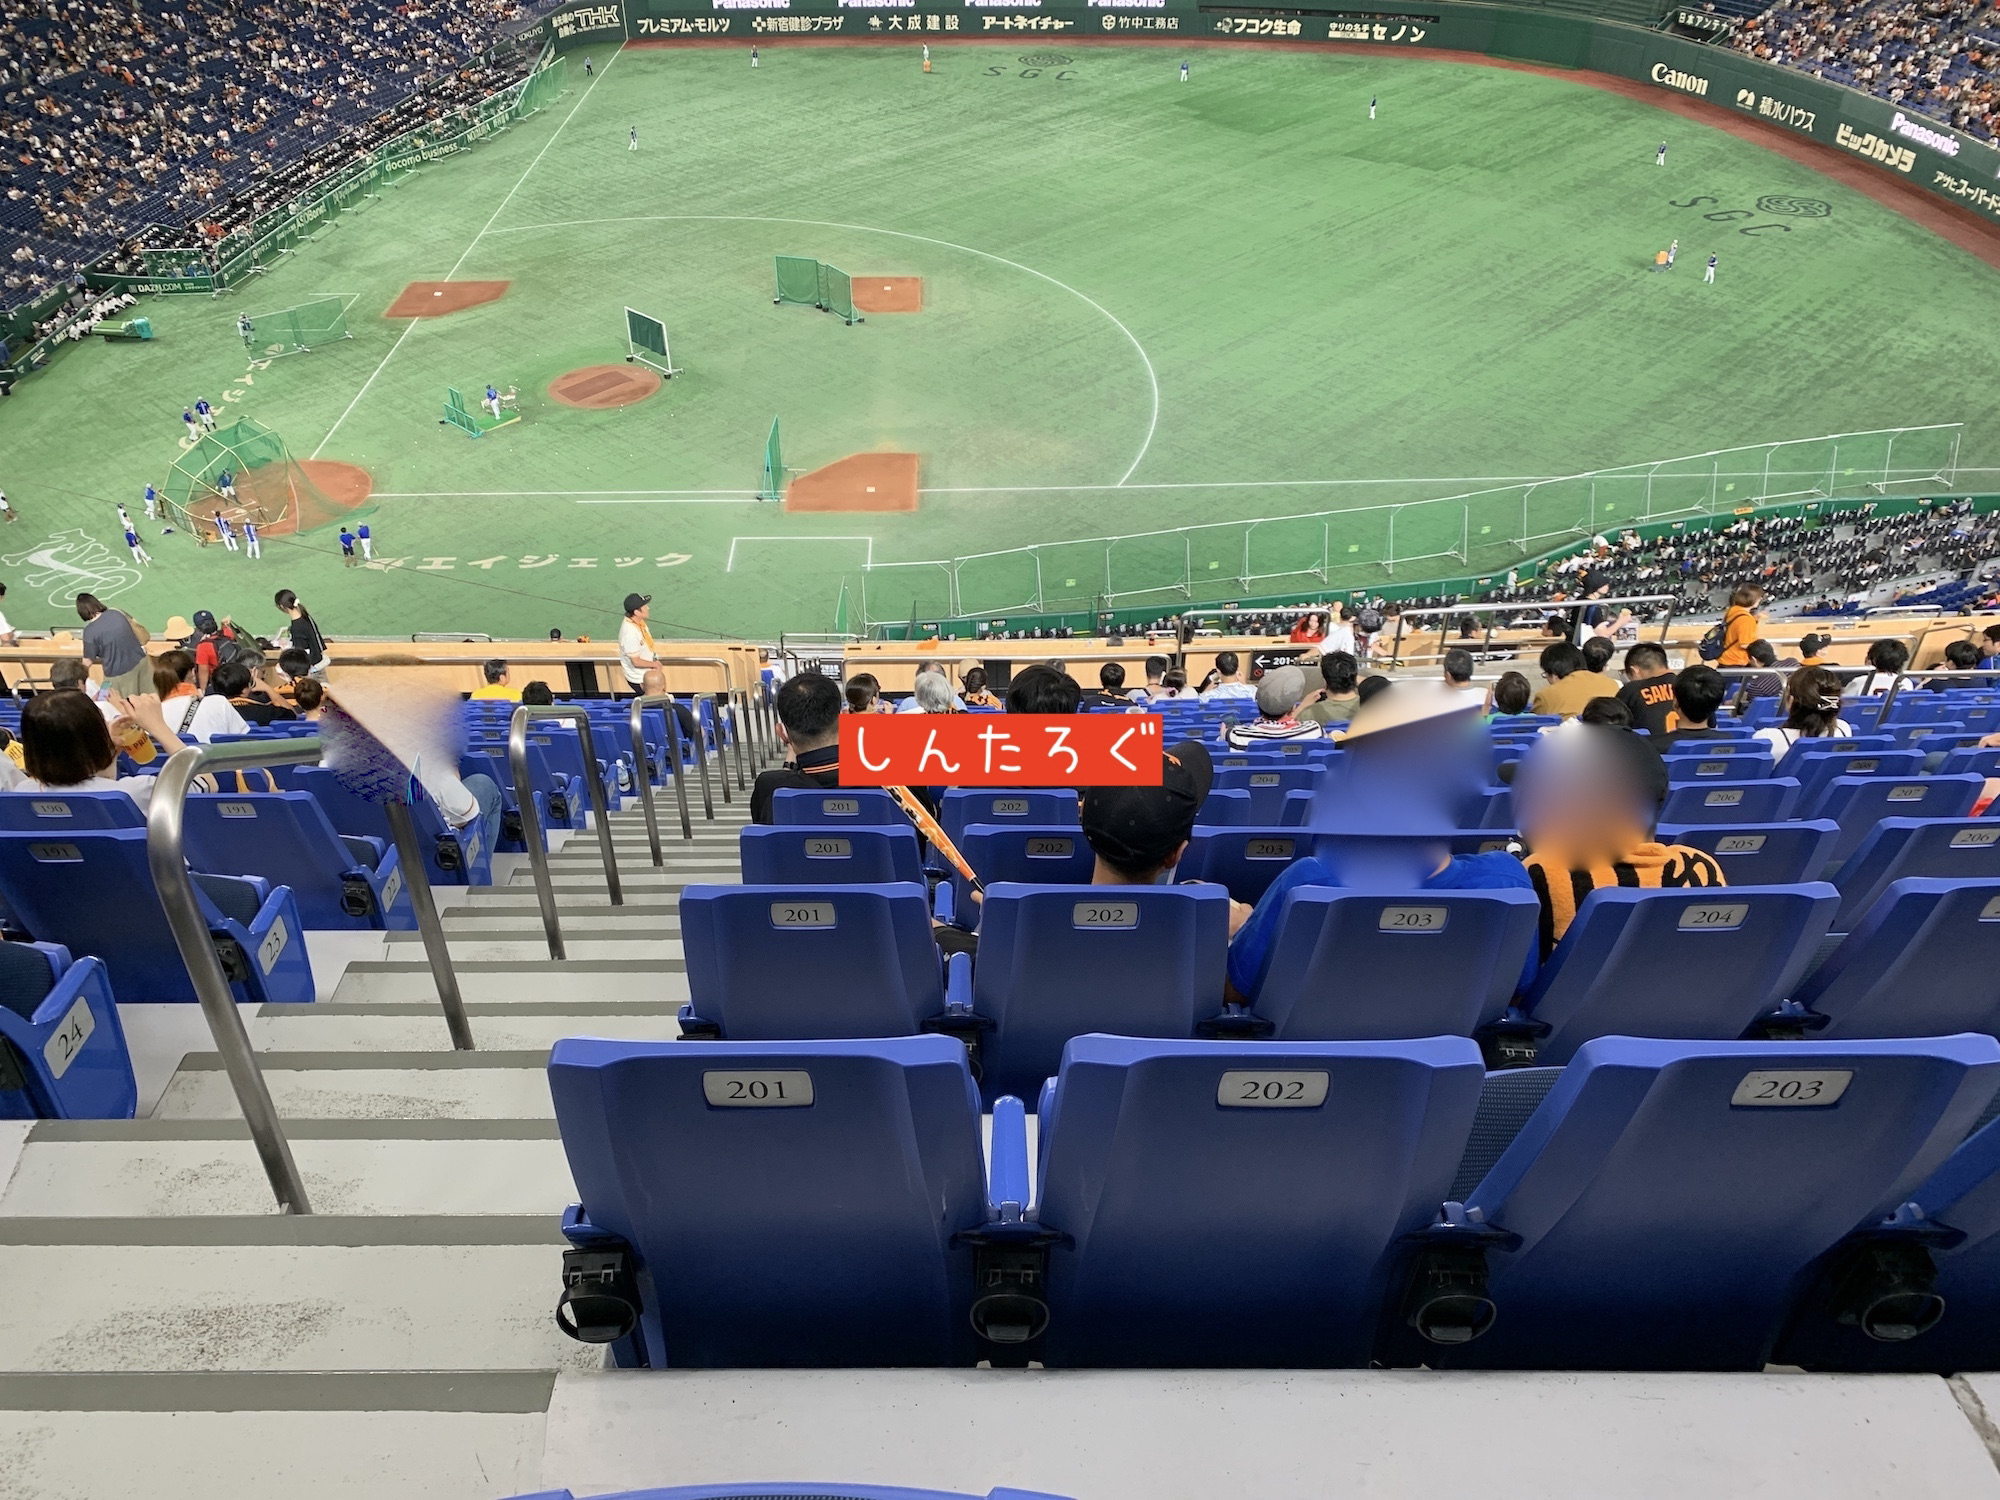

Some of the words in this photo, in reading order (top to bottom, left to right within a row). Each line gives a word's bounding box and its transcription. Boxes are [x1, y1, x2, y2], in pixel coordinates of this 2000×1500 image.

[574, 4, 620, 27] THK
[888, 14, 960, 31] 大成建設
[982, 14, 1074, 30] アートネイチャー
[1118, 16, 1179, 30] 竹中工務店
[1678, 12, 1728, 31] 日本アンテナ
[637, 17, 730, 34] プレミアム・モルツ
[766, 16, 844, 32] 新宿健診プラザ
[1233, 18, 1302, 36] フコク生命
[1329, 22, 1370, 33] 守りの名手
[1372, 23, 1426, 43] セノン
[1651, 62, 1709, 96] Canon
[1759, 96, 1817, 132] 積水ハウス
[1891, 111, 1960, 157] Panasonic
[1836, 122, 1917, 173] ビックカメラ
[385, 155, 421, 172] docomo
[420, 142, 458, 161] business
[137, 282, 182, 293] DAZN.COM
[1713, 793, 1735, 802] 206
[40, 804, 63, 813] 190
[226, 804, 249, 814] 191
[831, 803, 851, 812] 201
[1000, 803, 1022, 812] 202
[1725, 840, 1755, 850] 205
[1961, 832, 1990, 843] 206
[42, 847, 70, 858] 191
[814, 843, 841, 854] 201
[1036, 843, 1064, 853] 202
[1256, 844, 1284, 855] 203
[784, 909, 822, 923] 201
[1086, 909, 1124, 923] 202
[1392, 912, 1433, 927] 203
[1691, 909, 1735, 925] 204
[265, 931, 282, 962] 23
[57, 1014, 84, 1061] 24
[726, 1080, 789, 1100] 201
[1240, 1080, 1305, 1101] 202
[1752, 1080, 1824, 1101] 203
